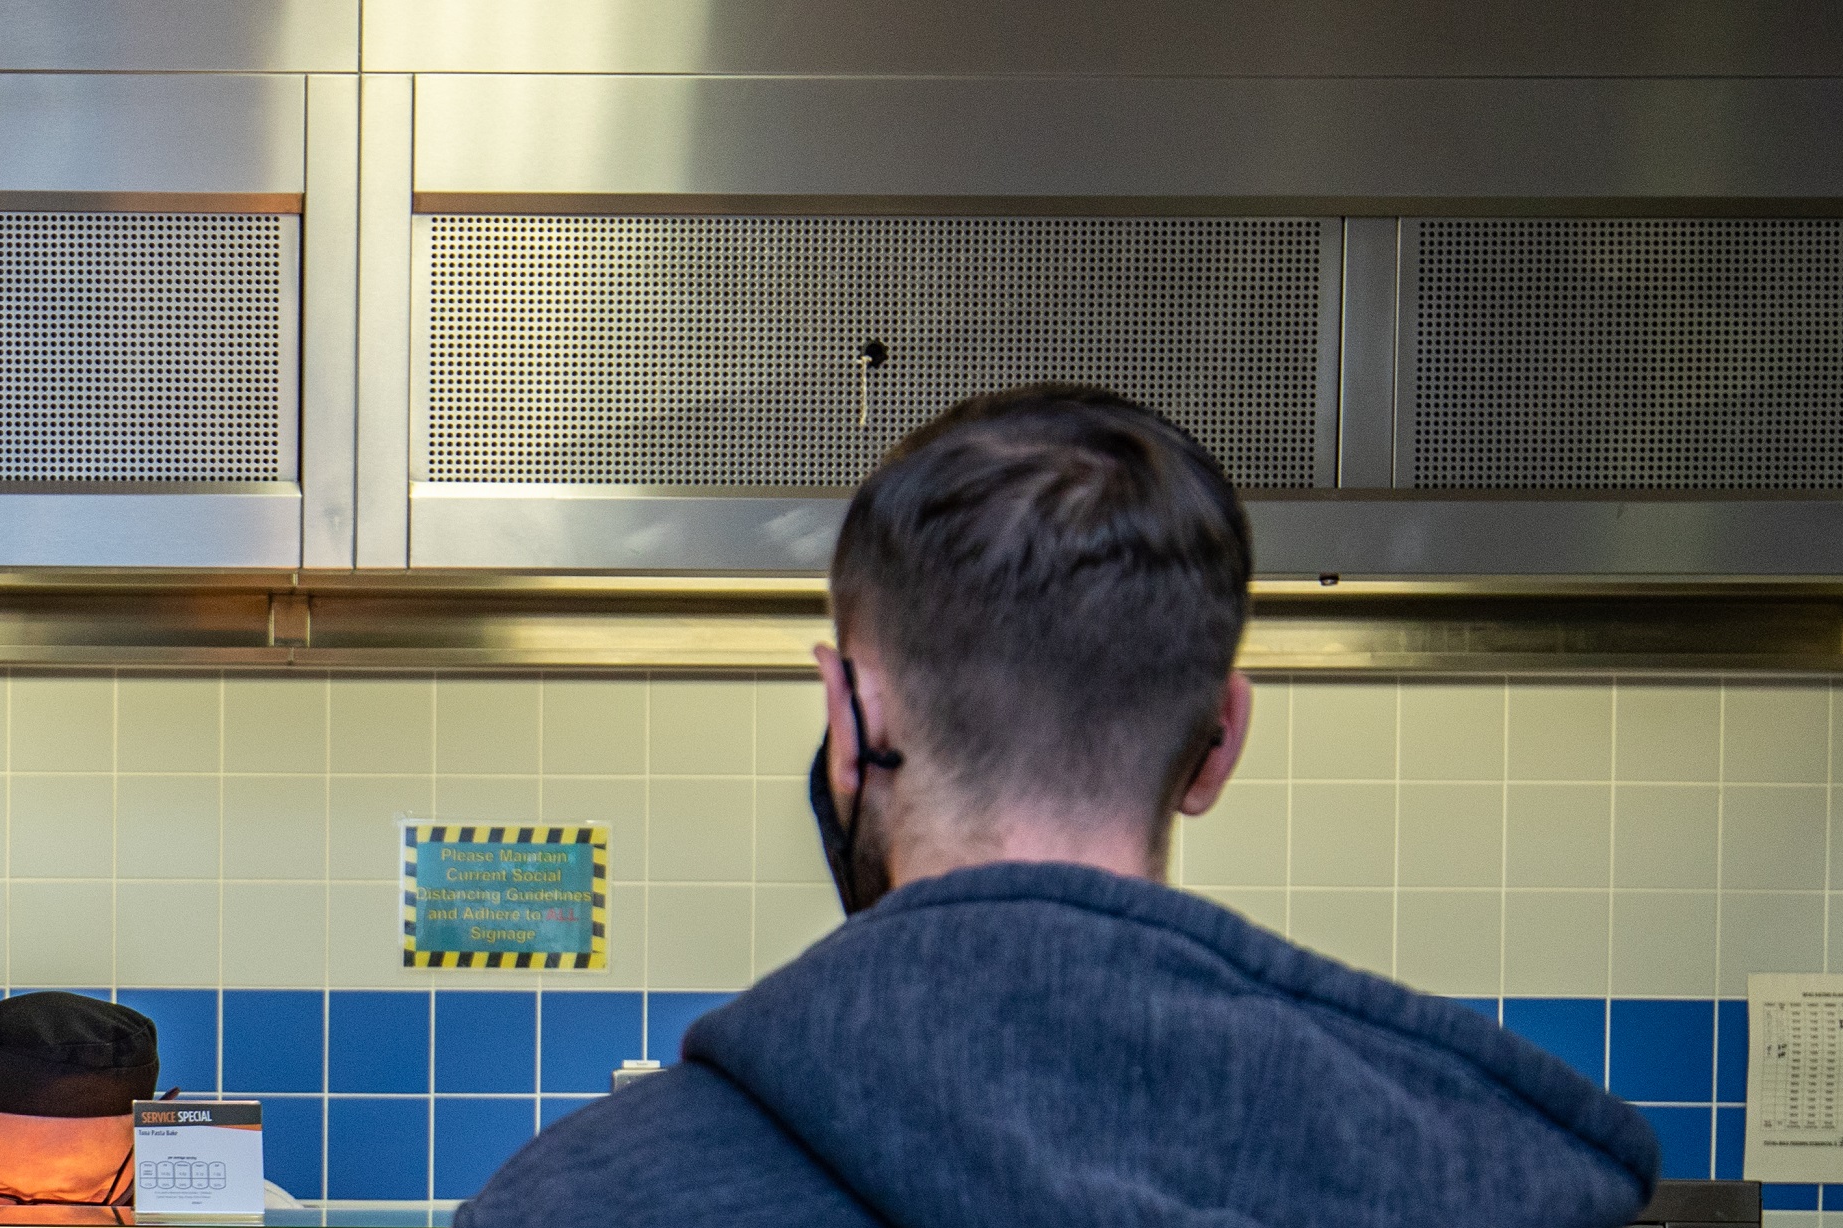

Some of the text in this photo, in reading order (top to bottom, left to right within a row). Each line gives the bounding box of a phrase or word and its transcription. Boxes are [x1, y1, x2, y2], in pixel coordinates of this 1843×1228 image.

[441, 848, 569, 863] Please Maintain
[446, 867, 562, 882] Current Social
[416, 887, 592, 903] Distancing Guidelines
[428, 907, 579, 922] and Adhere to ALL
[470, 926, 536, 943] Signage
[141, 1110, 213, 1123] SERVICE SPECIAL
